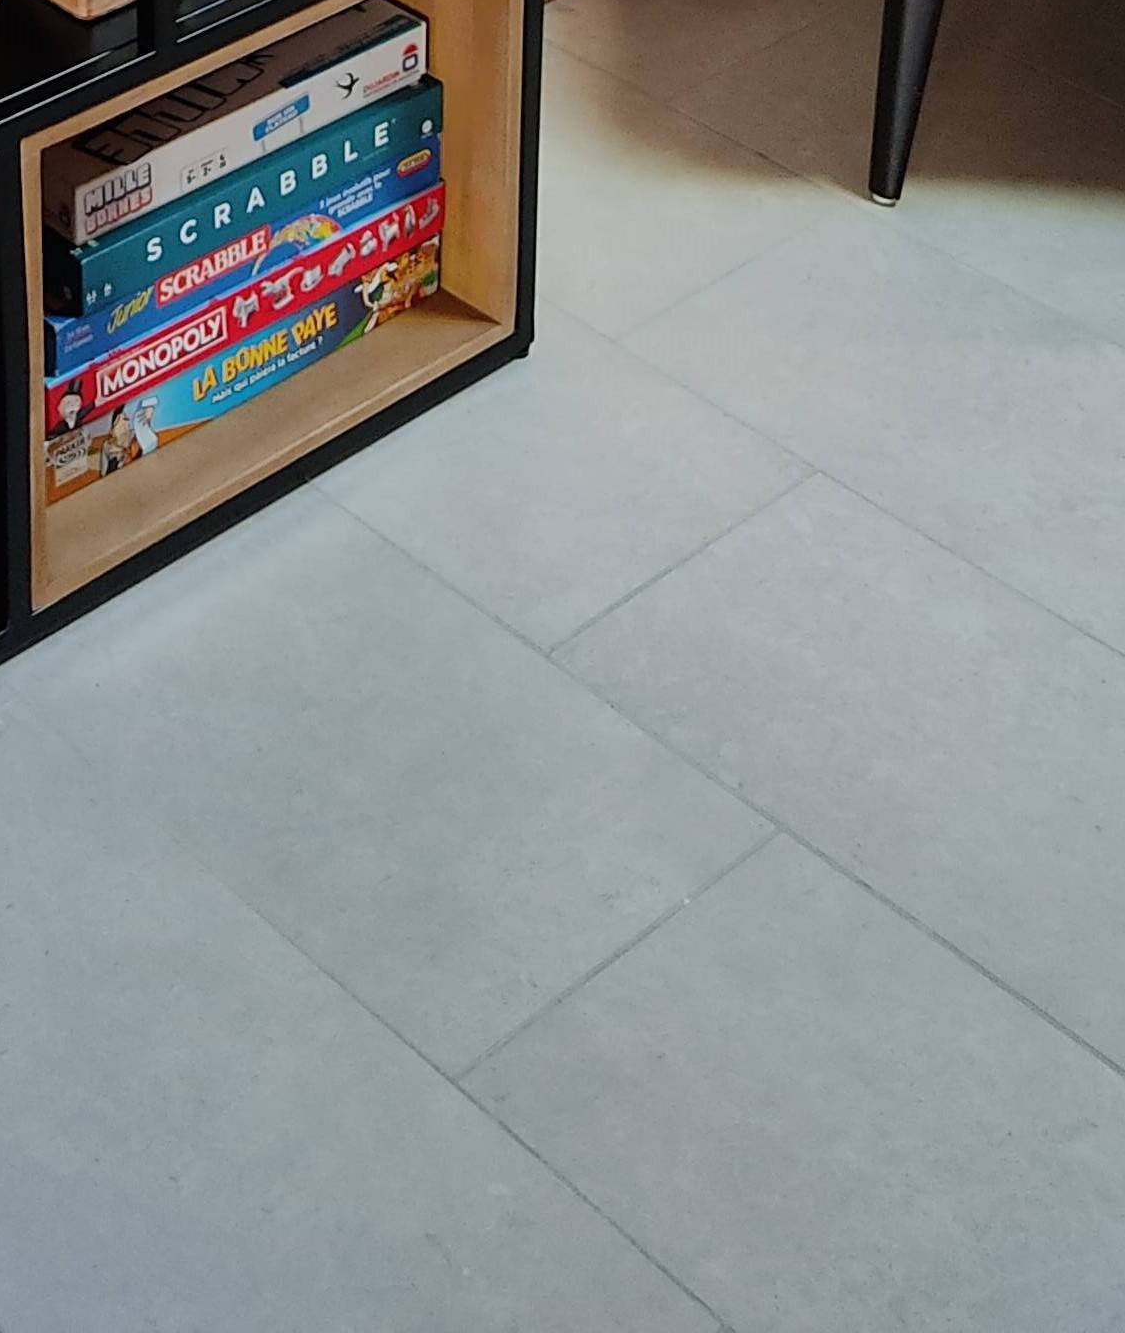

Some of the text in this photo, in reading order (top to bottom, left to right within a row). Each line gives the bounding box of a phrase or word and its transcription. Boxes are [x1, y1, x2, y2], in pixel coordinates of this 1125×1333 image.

[84, 162, 152, 215] MILLE
[85, 186, 153, 234] BORNES
[146, 121, 390, 262] SCRABBLE
[107, 230, 268, 333] Junior SCRABBLE
[102, 314, 222, 397] MONOPOLY
[193, 302, 337, 402] LA BONNE PAYE
[233, 377, 249, 392] qui
